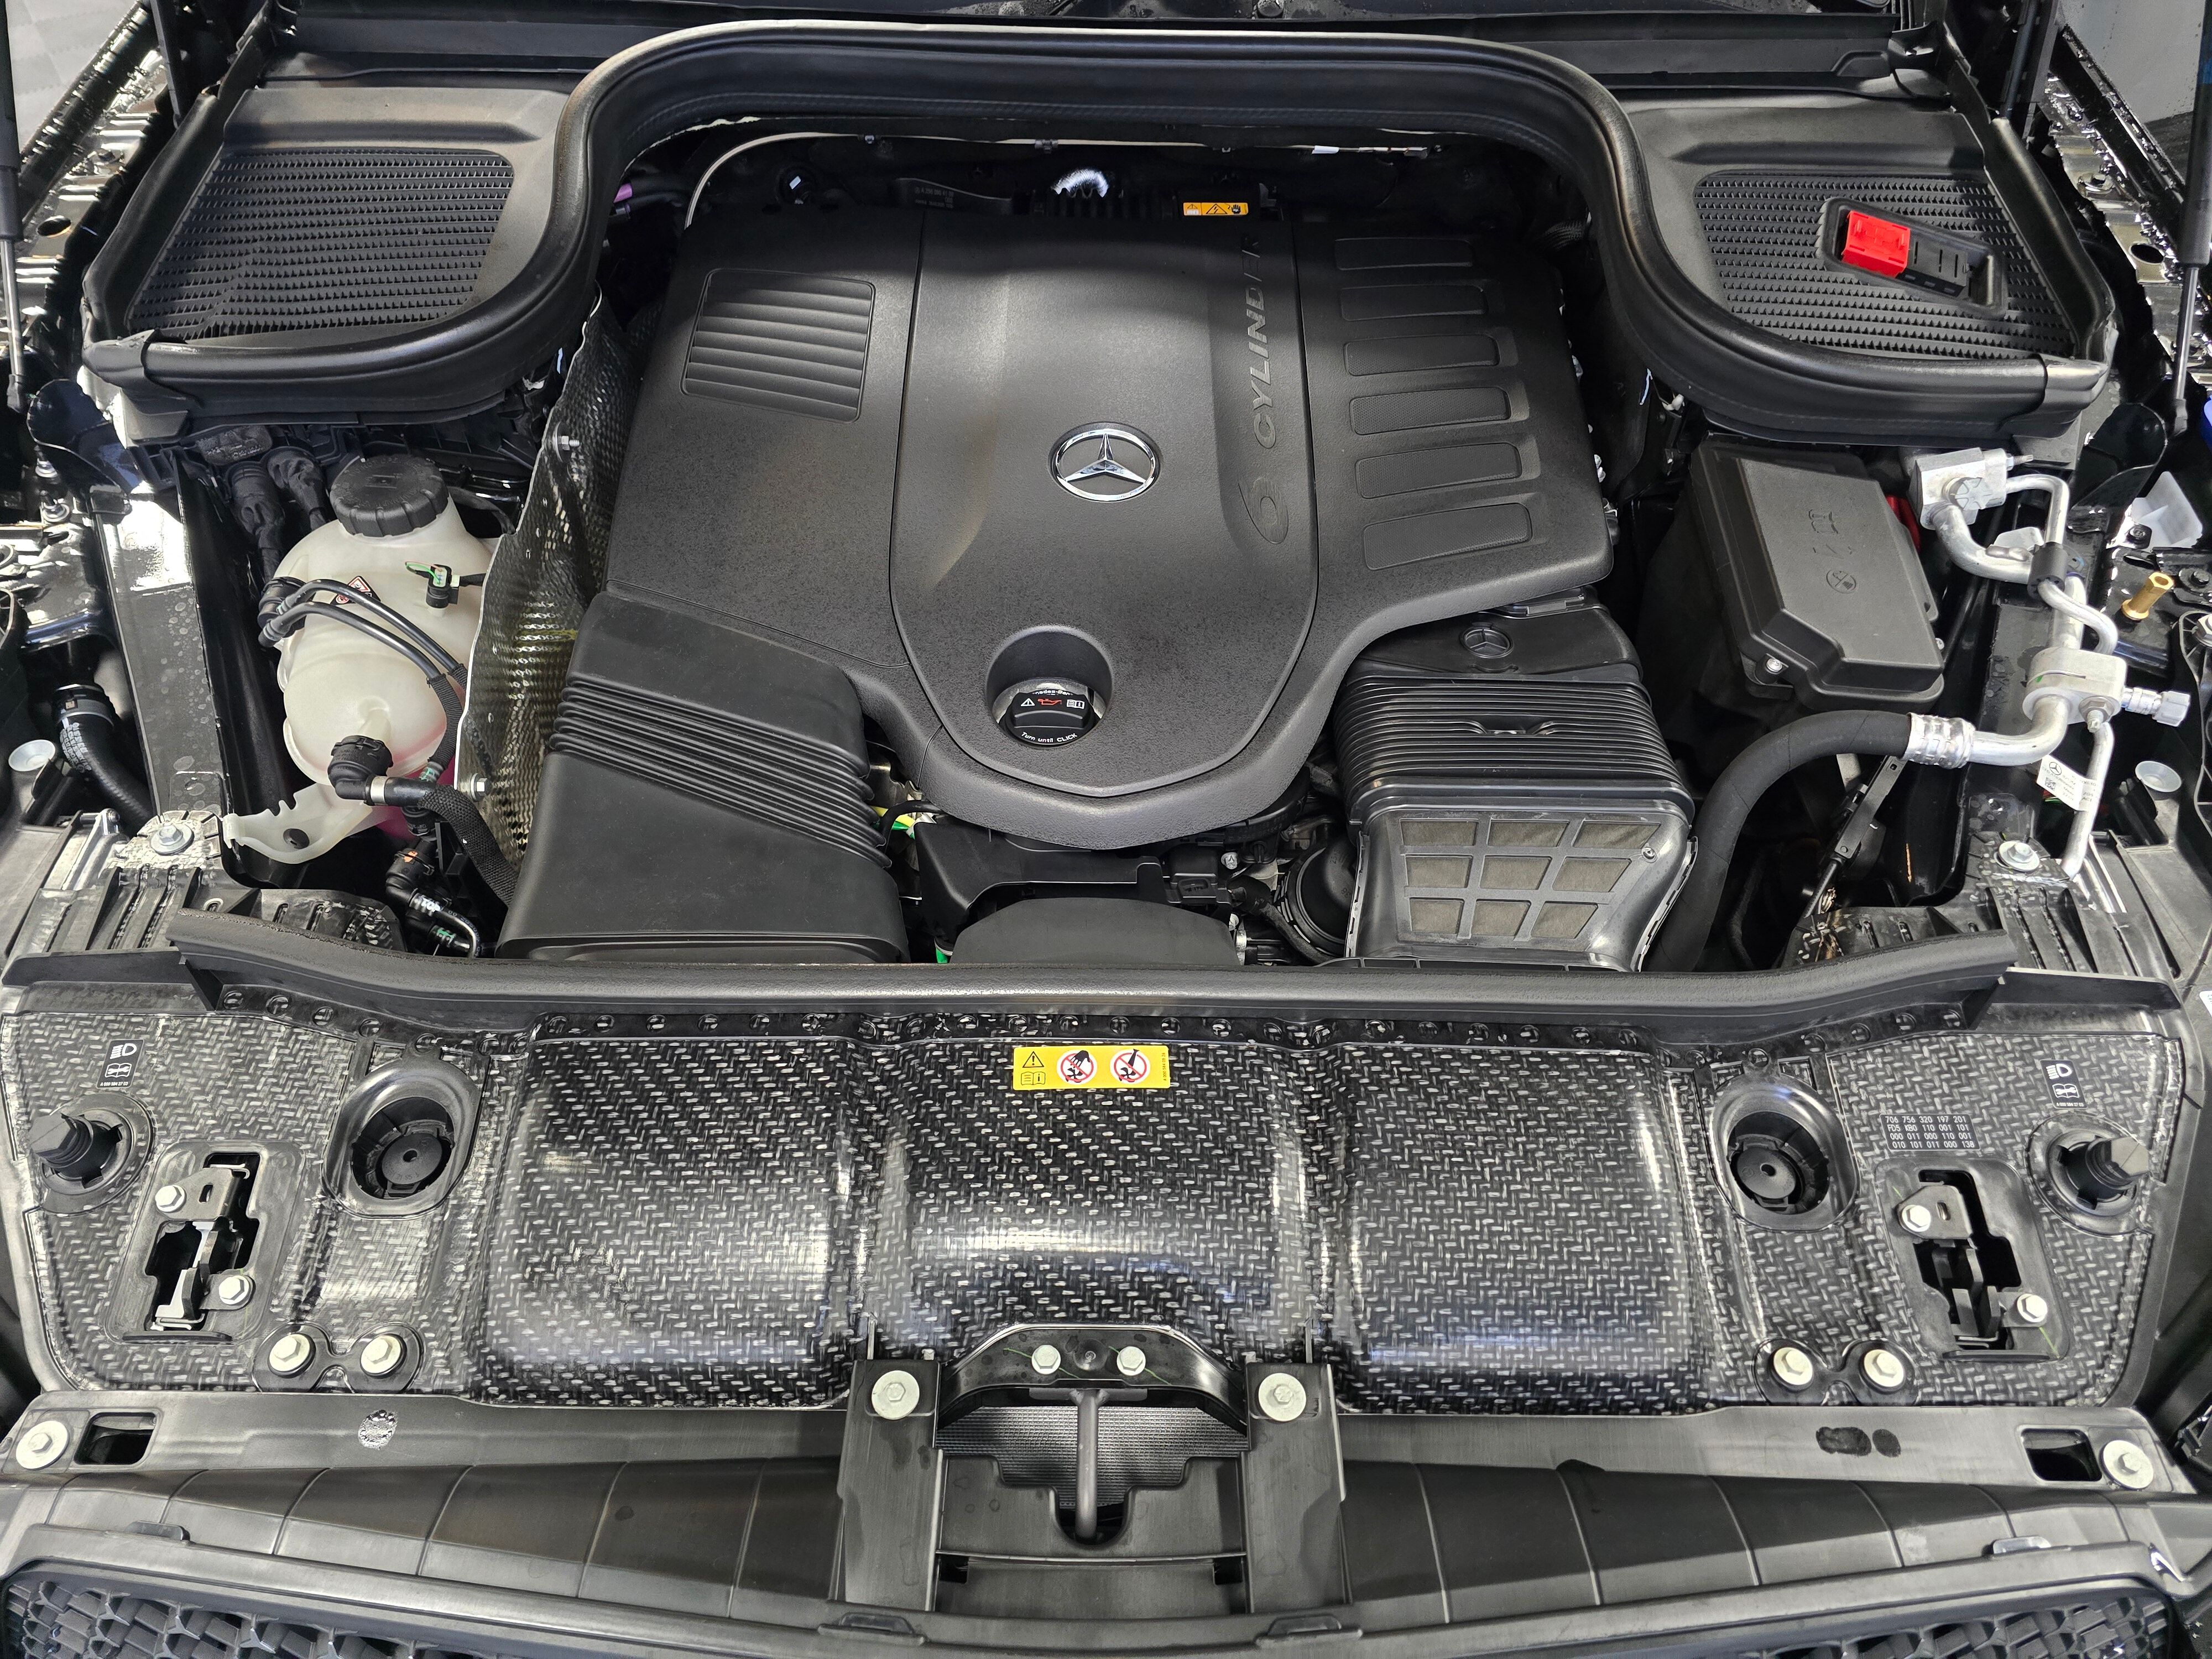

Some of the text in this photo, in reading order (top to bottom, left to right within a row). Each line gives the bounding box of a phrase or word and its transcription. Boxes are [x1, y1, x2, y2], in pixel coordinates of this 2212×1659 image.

[1238, 235, 1289, 545] 6 CYLINDER
[1021, 732, 1036, 741] Turn
[1056, 733, 1078, 742] CLICK
